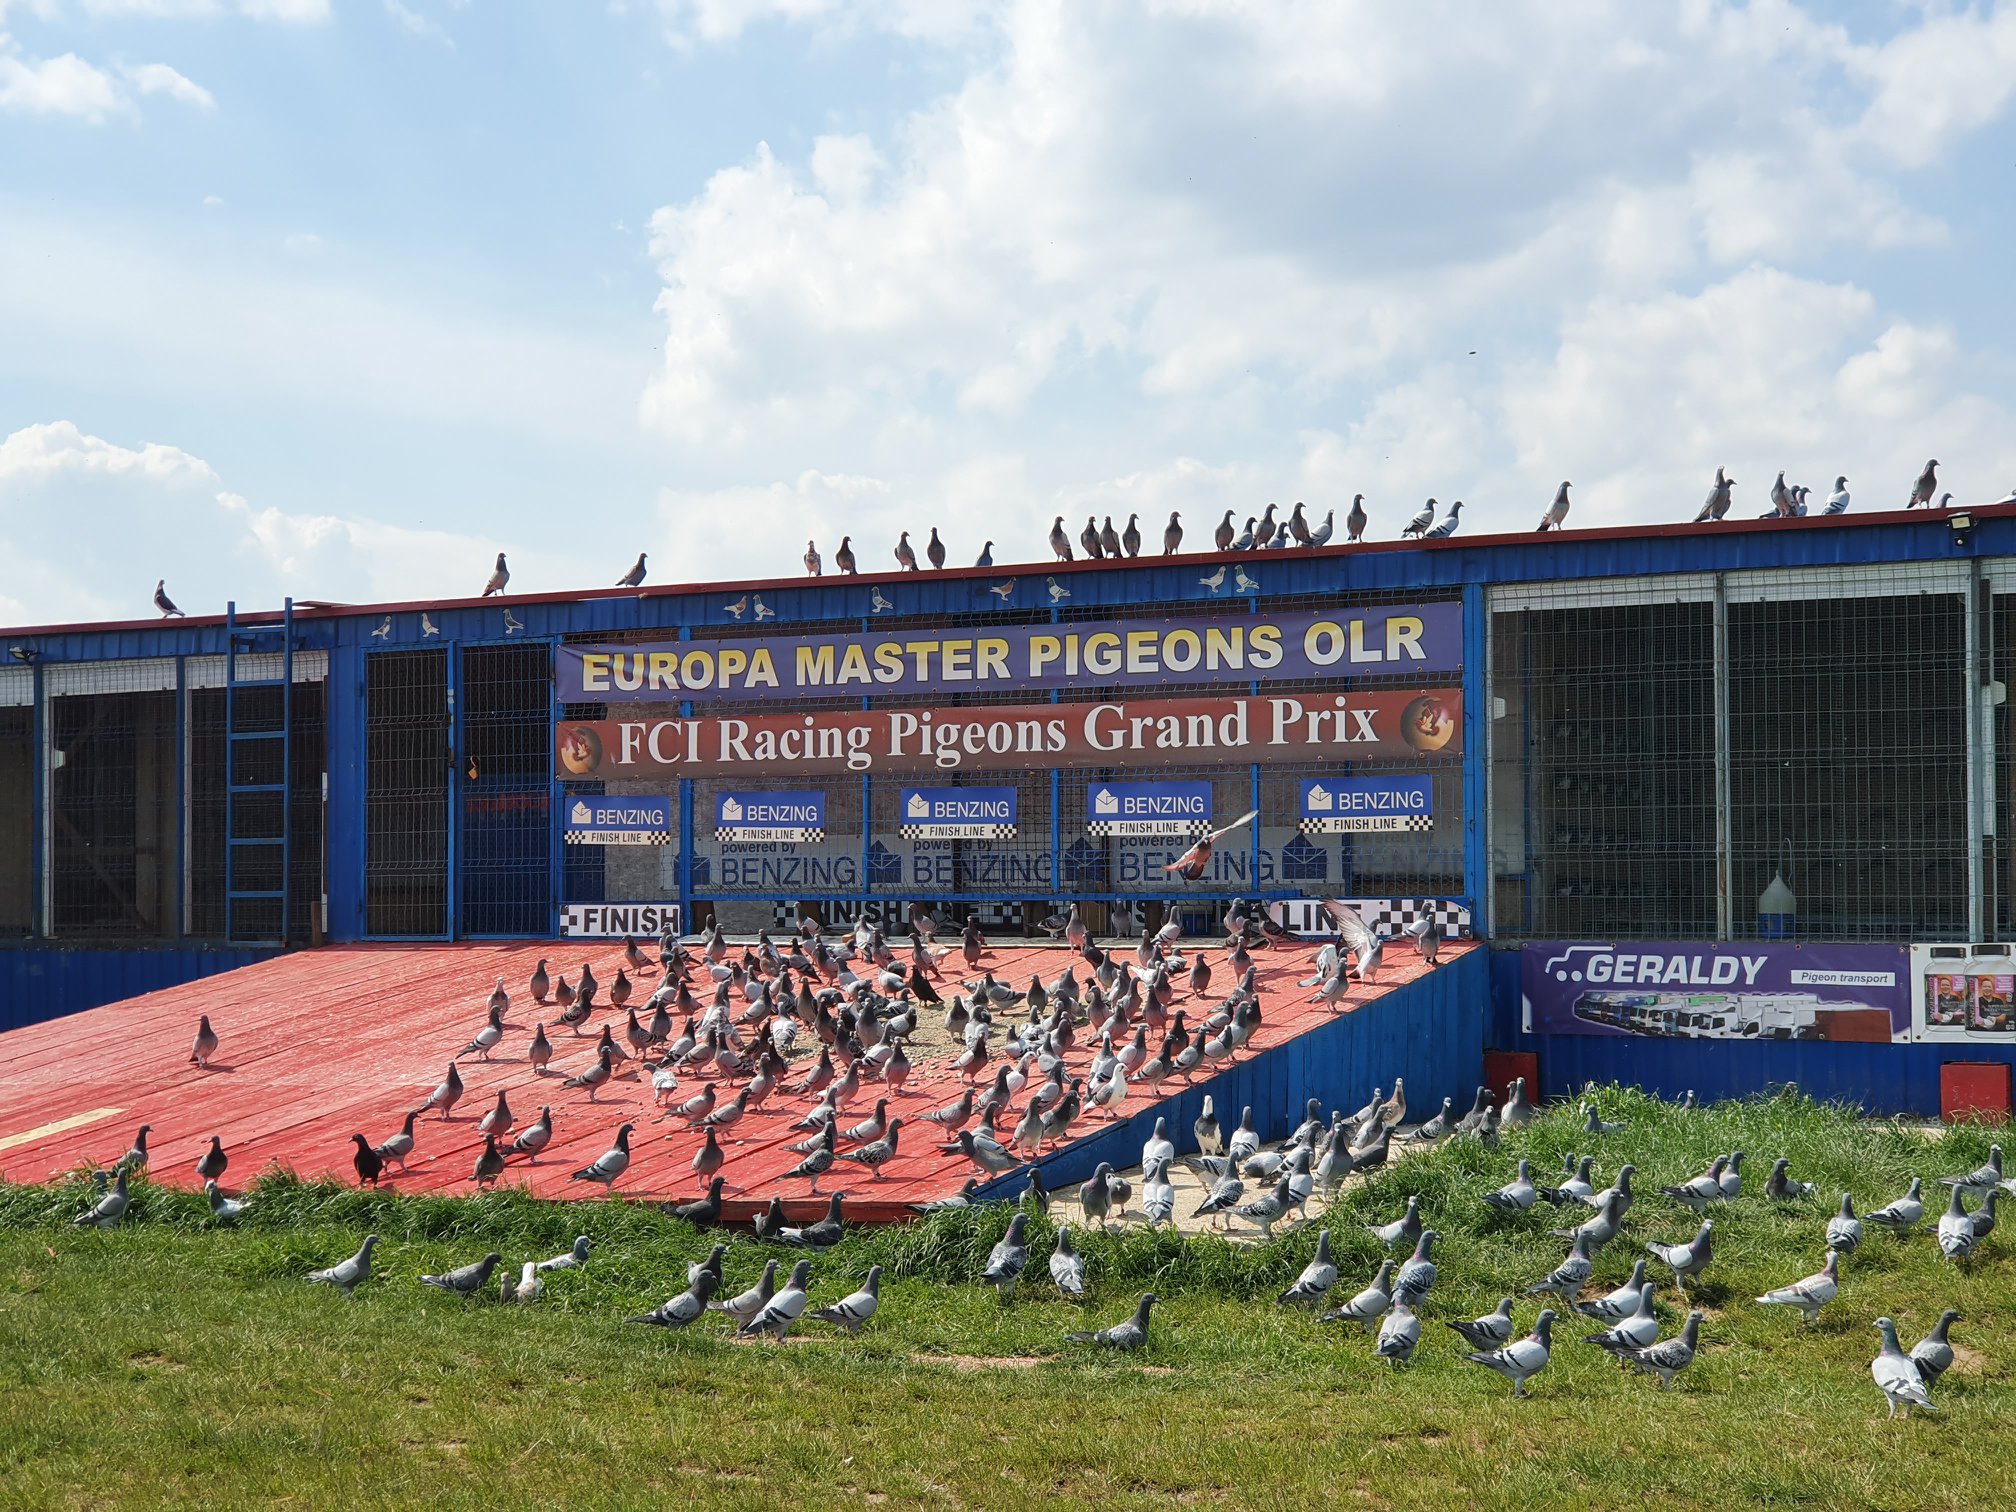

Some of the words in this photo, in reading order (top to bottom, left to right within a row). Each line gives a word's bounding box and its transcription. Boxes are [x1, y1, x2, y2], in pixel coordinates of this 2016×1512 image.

[582, 648, 780, 692] EUROPA
[795, 638, 1012, 687] MASTER
[1029, 624, 1284, 678] PIGEONS
[1304, 616, 1427, 666] OLR
[617, 720, 703, 765] FCI
[716, 716, 872, 771] Racing
[886, 711, 1067, 768] Pigeons
[1084, 700, 1250, 751] Grand
[1267, 696, 1380, 745] Prix
[1124, 796, 1204, 814] BENZING
[1338, 790, 1424, 810] BENZING
[596, 809, 664, 825] BENZING
[747, 805, 818, 822] BENZING
[934, 801, 1010, 818] BENZING
[929, 826, 960, 837] FINISH
[964, 826, 985, 837] LINE
[1119, 822, 1152, 834] FINISH
[1156, 822, 1179, 833] LINE
[1334, 819, 1373, 830] FINISH
[1373, 818, 1397, 829] LINE
[591, 832, 620, 843] FINISH
[622, 832, 642, 843] LINE
[742, 829, 772, 840] FINISH
[775, 829, 795, 840] LINE
[1119, 835, 1183, 849] powered
[721, 842, 777, 855] powered
[781, 842, 796, 854] by
[721, 856, 856, 885] BENZING
[1120, 850, 1274, 882] BENING
[583, 907, 679, 933] FINISH
[1586, 954, 1768, 985] GERALDY
[1801, 971, 1837, 984] Pigeon
[1840, 973, 1888, 985] transport
